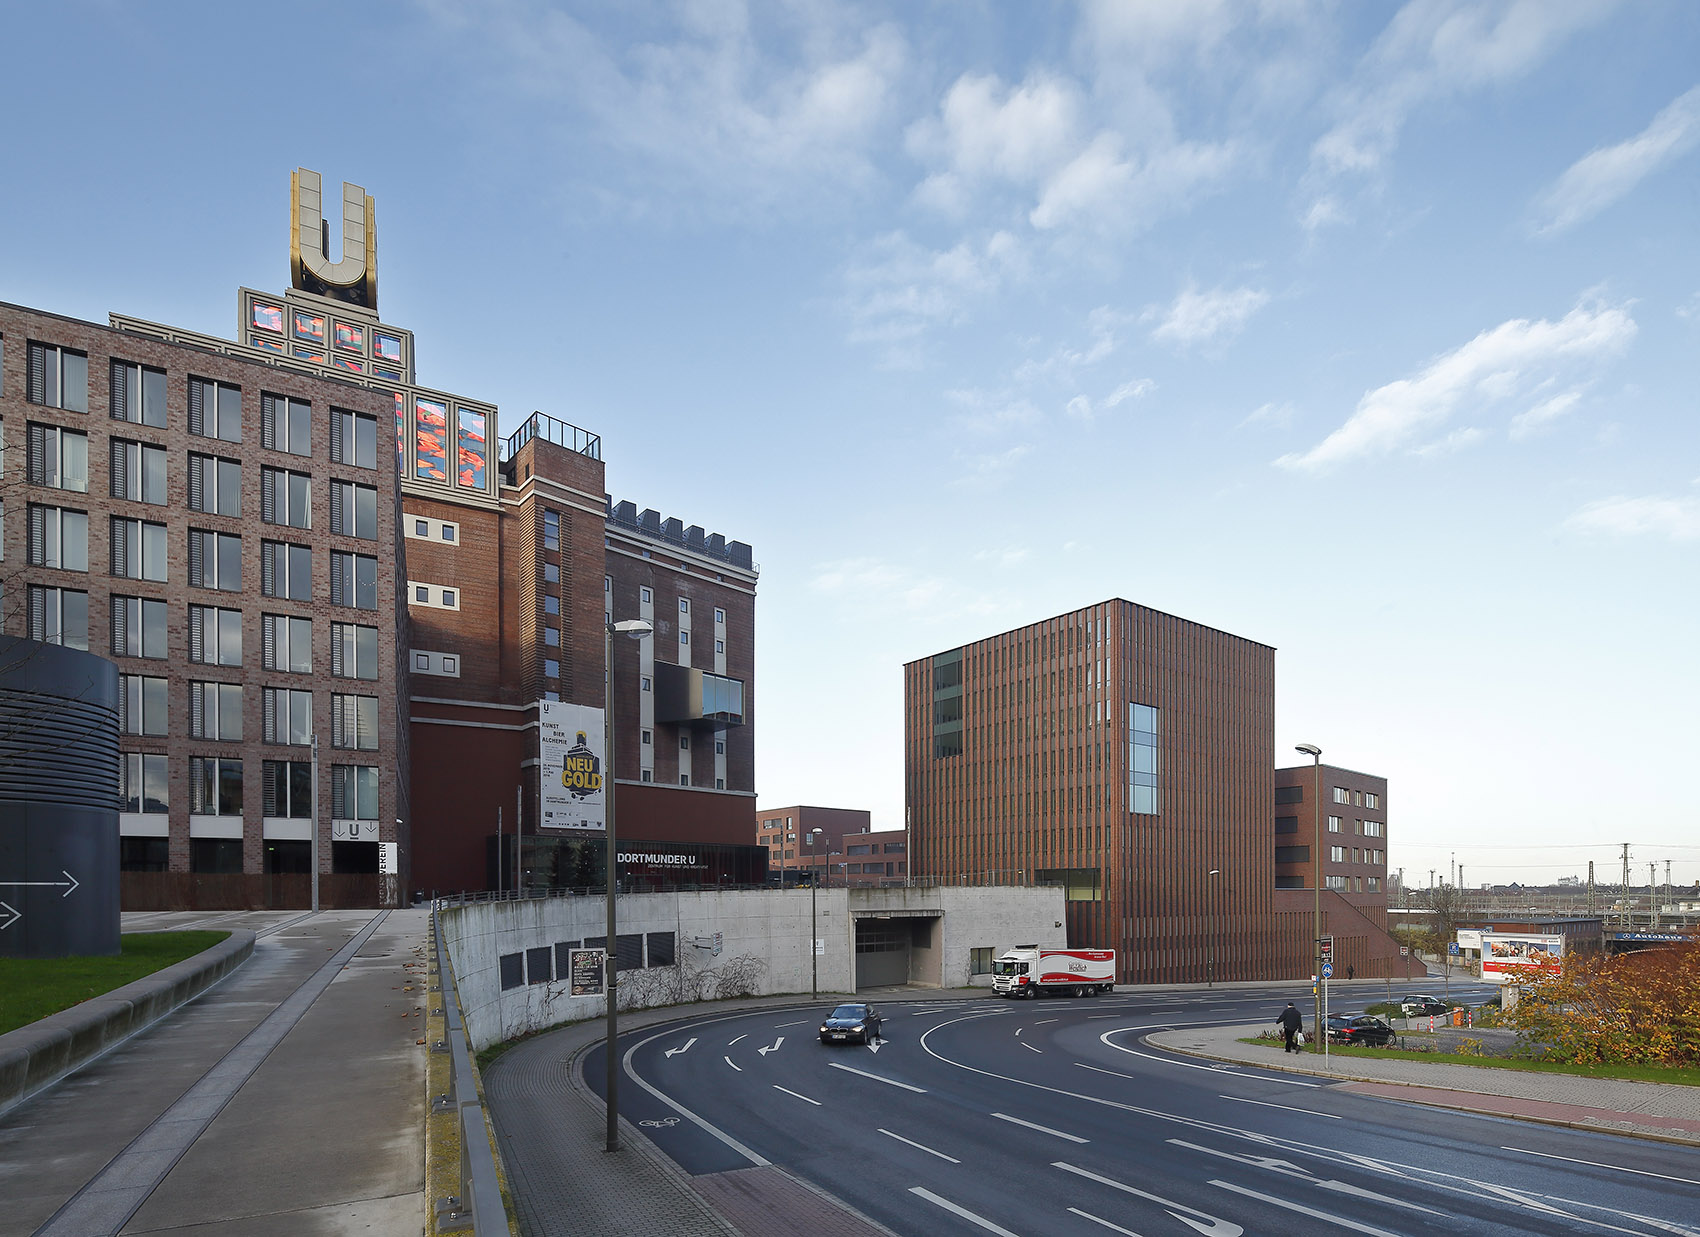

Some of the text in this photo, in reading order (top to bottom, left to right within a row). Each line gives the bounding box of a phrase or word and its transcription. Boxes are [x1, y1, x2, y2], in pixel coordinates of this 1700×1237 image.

[292, 167, 374, 290] U
[543, 703, 549, 712] U
[542, 737, 568, 745] ALCHEMIE
[567, 757, 593, 772] NEU
[562, 770, 602, 789] GOLD
[349, 823, 359, 836] U
[617, 853, 696, 865] DORTMUNDER U
